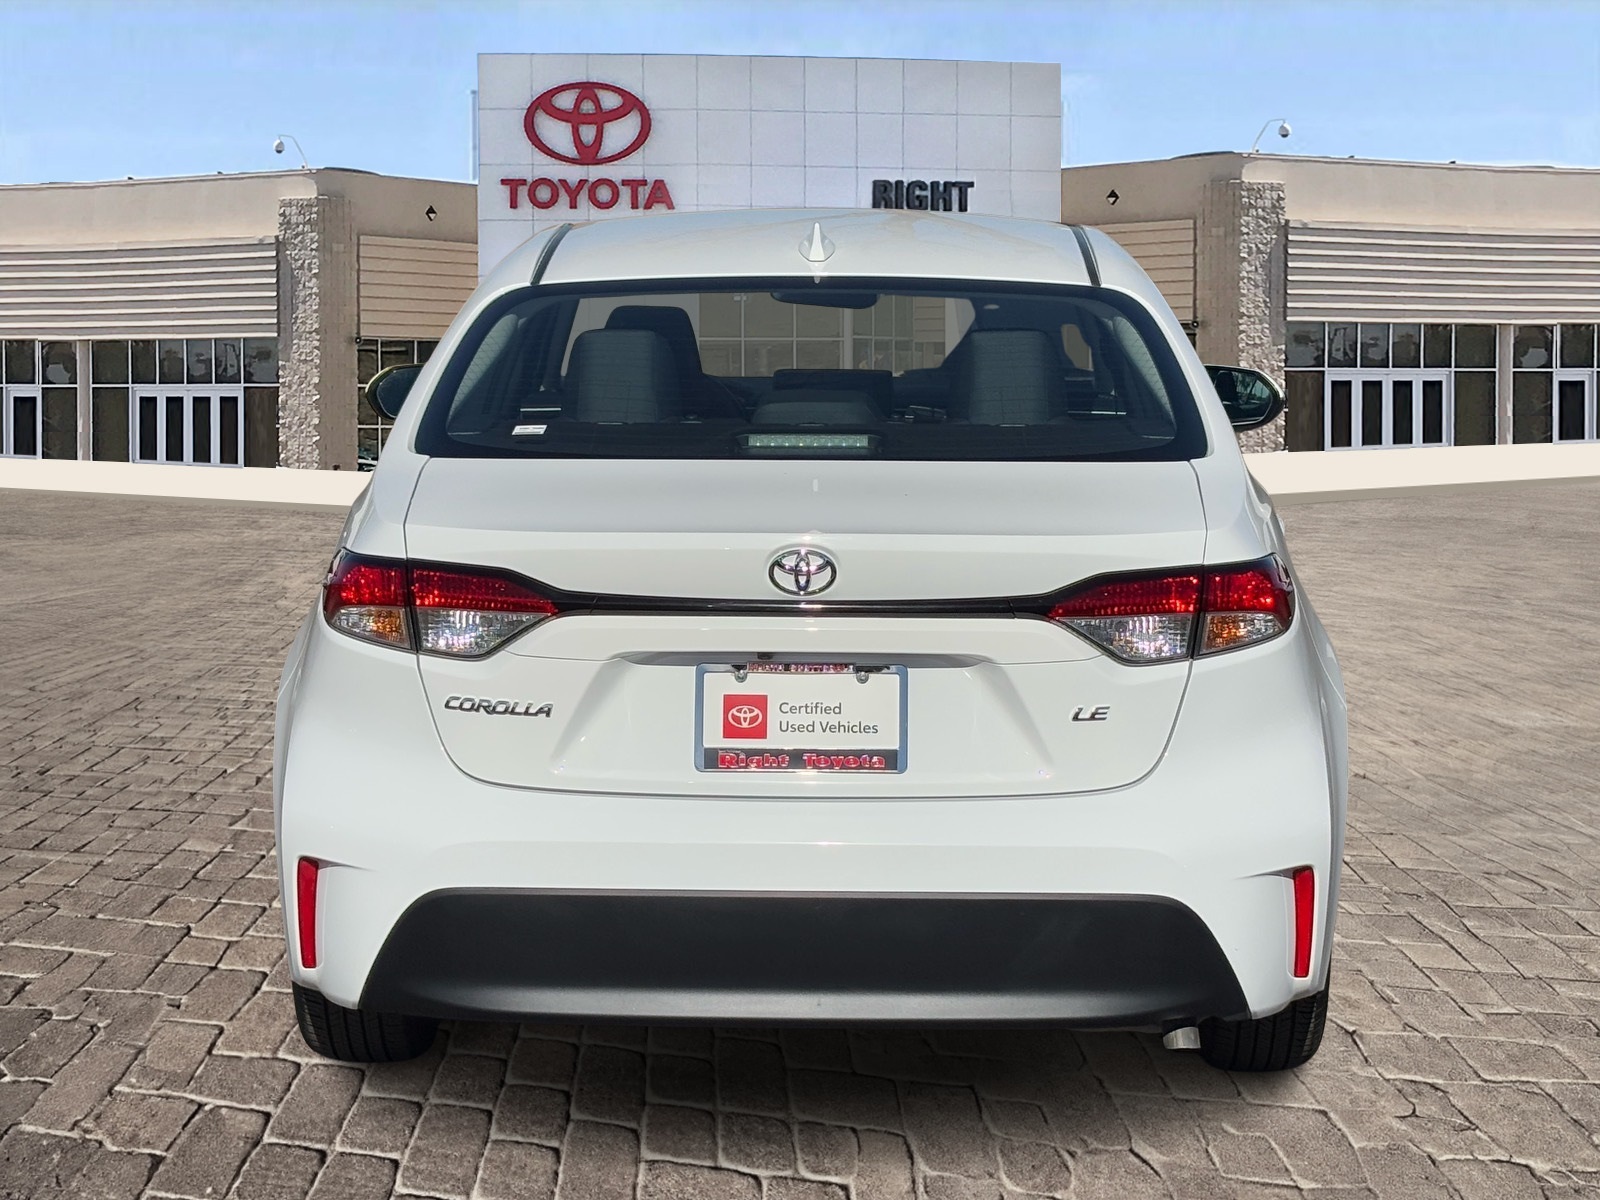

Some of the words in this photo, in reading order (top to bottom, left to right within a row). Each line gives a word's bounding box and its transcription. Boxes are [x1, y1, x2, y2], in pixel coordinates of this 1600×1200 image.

[500, 177, 675, 209] TOYOTA
[872, 179, 975, 212] RIGHT
[444, 696, 554, 718] COROLLA
[778, 702, 842, 715] Certified
[1071, 705, 1110, 721] LE
[778, 720, 815, 733] Used
[820, 721, 879, 734] Vehicles
[718, 751, 790, 769] Right
[802, 753, 886, 770] Toyota
